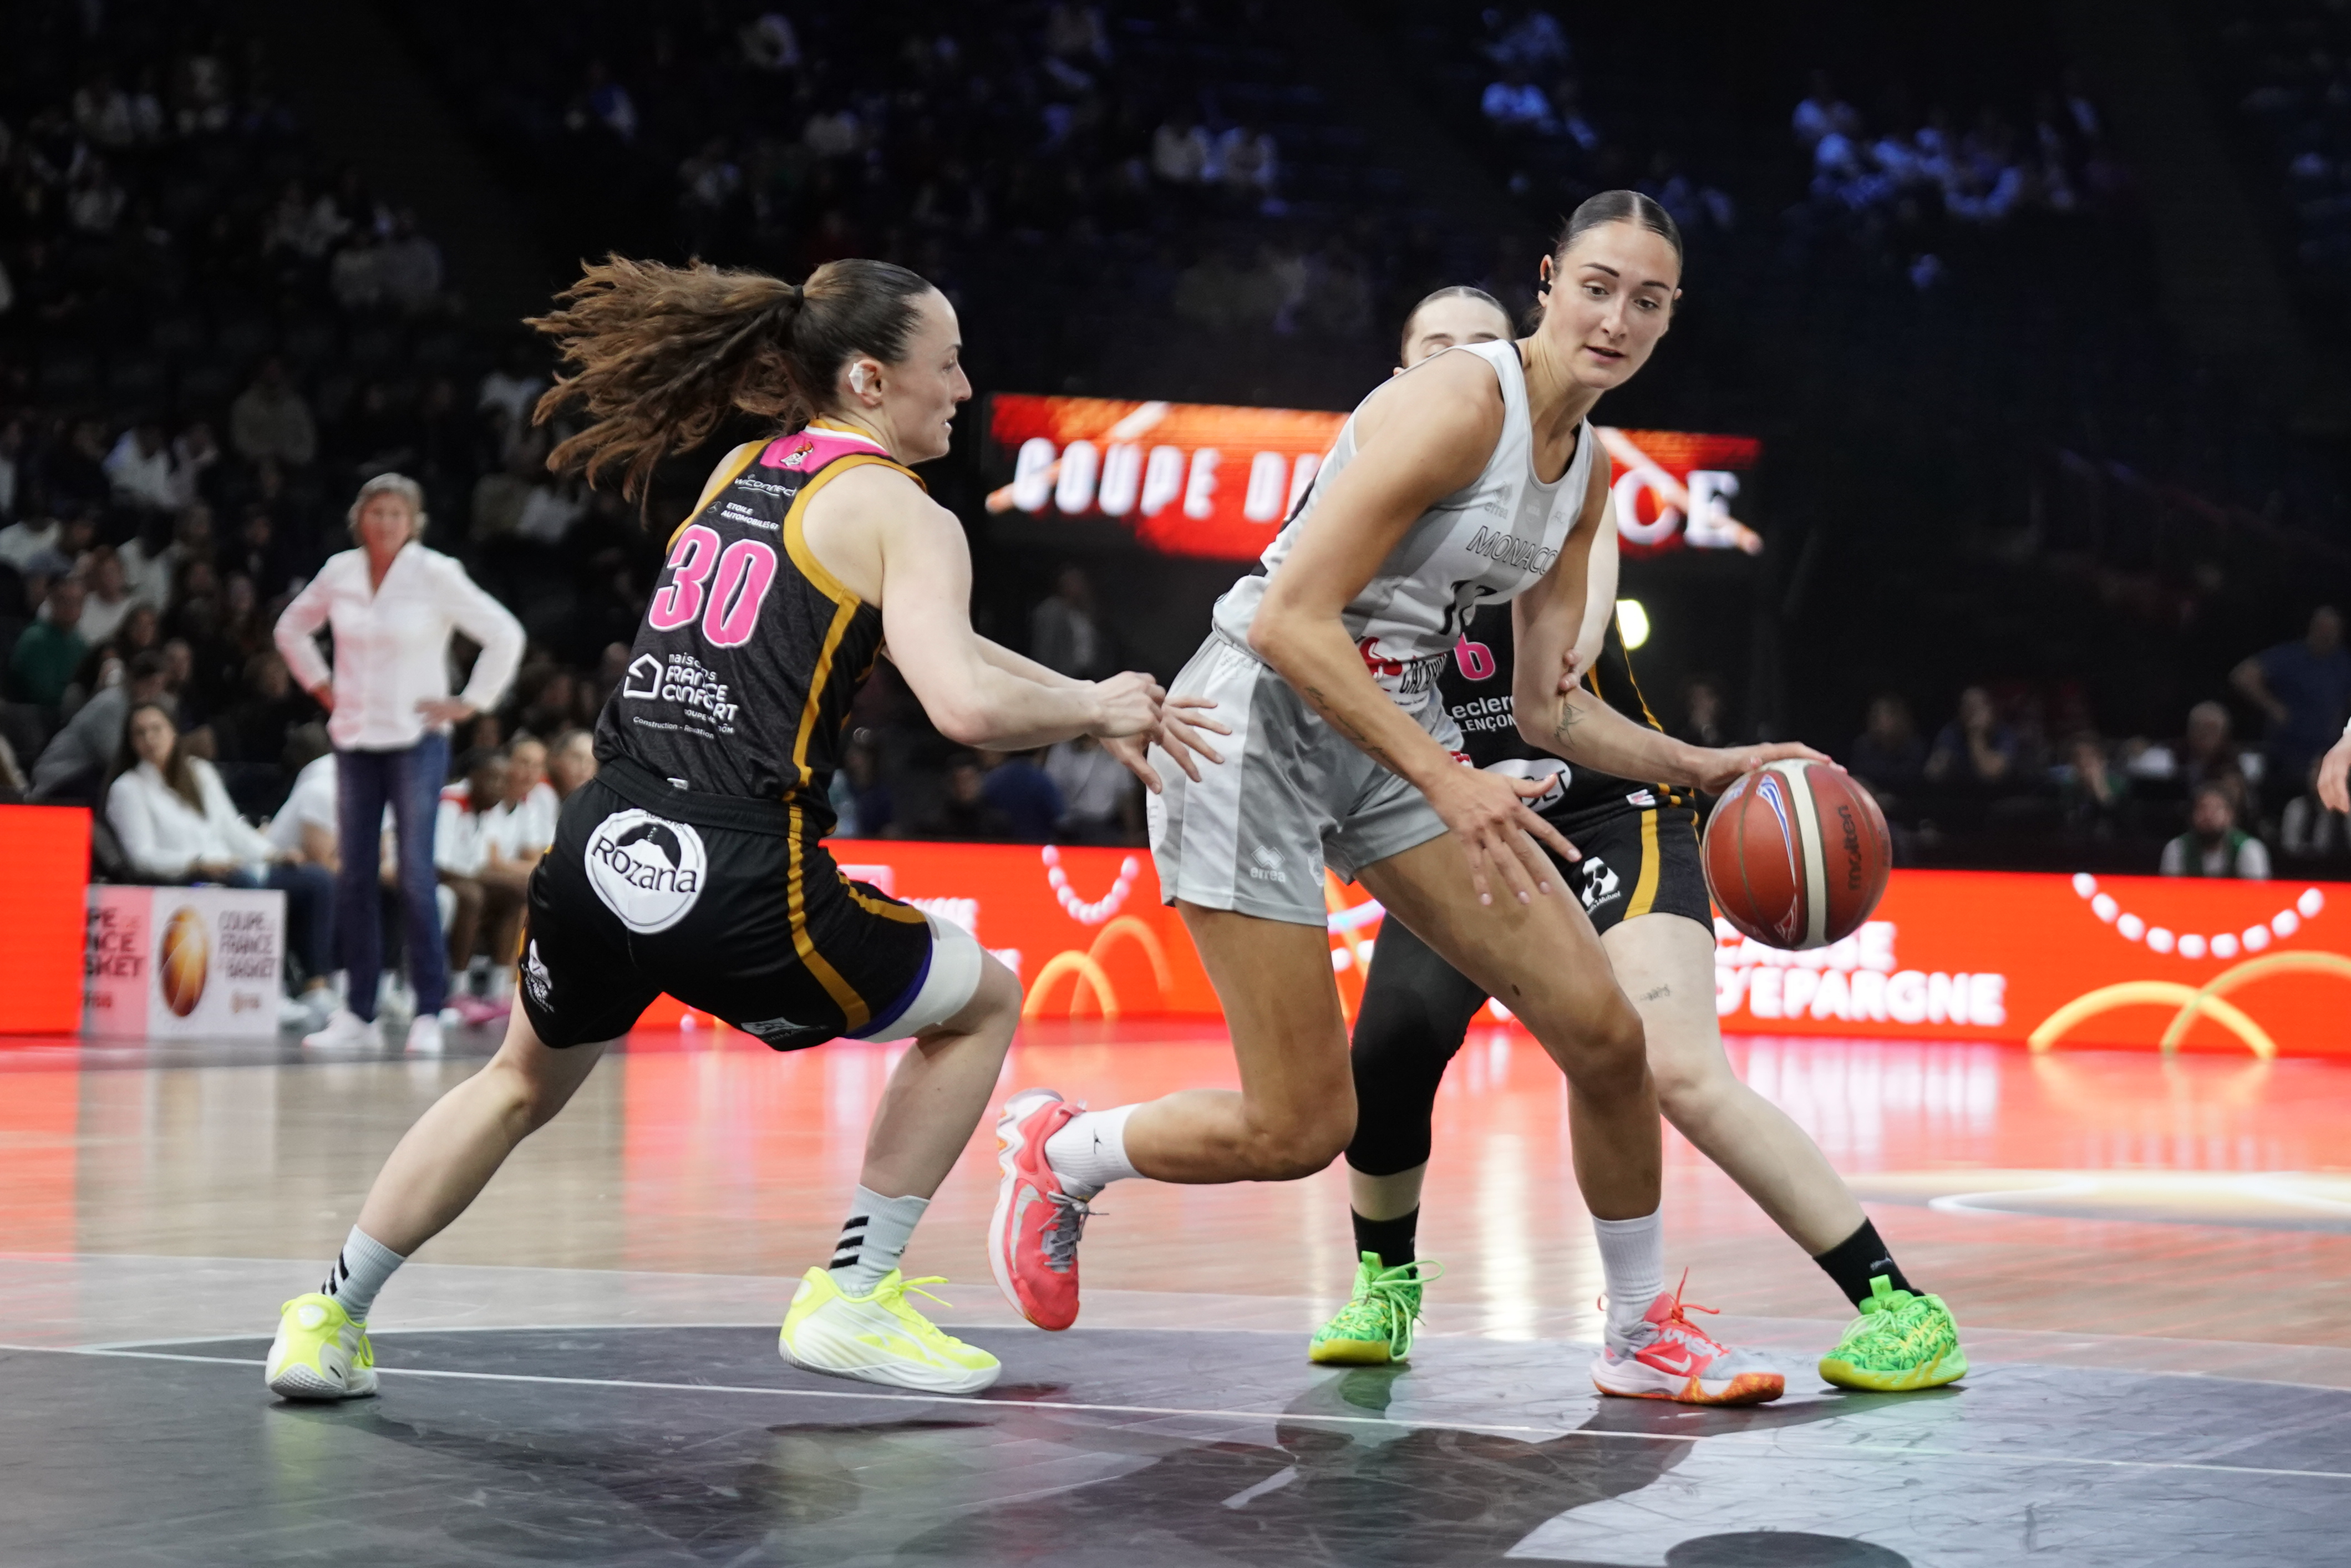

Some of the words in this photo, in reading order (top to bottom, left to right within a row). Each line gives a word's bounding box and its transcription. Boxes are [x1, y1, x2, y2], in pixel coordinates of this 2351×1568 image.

[1013, 437, 1221, 520] COUPE
[721, 510, 770, 529] AUTOMOBILES
[726, 502, 753, 515] ETOILE
[648, 523, 777, 649] 30
[668, 652, 717, 681] maisons
[633, 716, 678, 730] Construction
[1456, 713, 1517, 732] LENÇON
[590, 834, 698, 893] Rozana
[1250, 866, 1286, 883] errea
[1714, 965, 2005, 1026] D'EPARGNE
